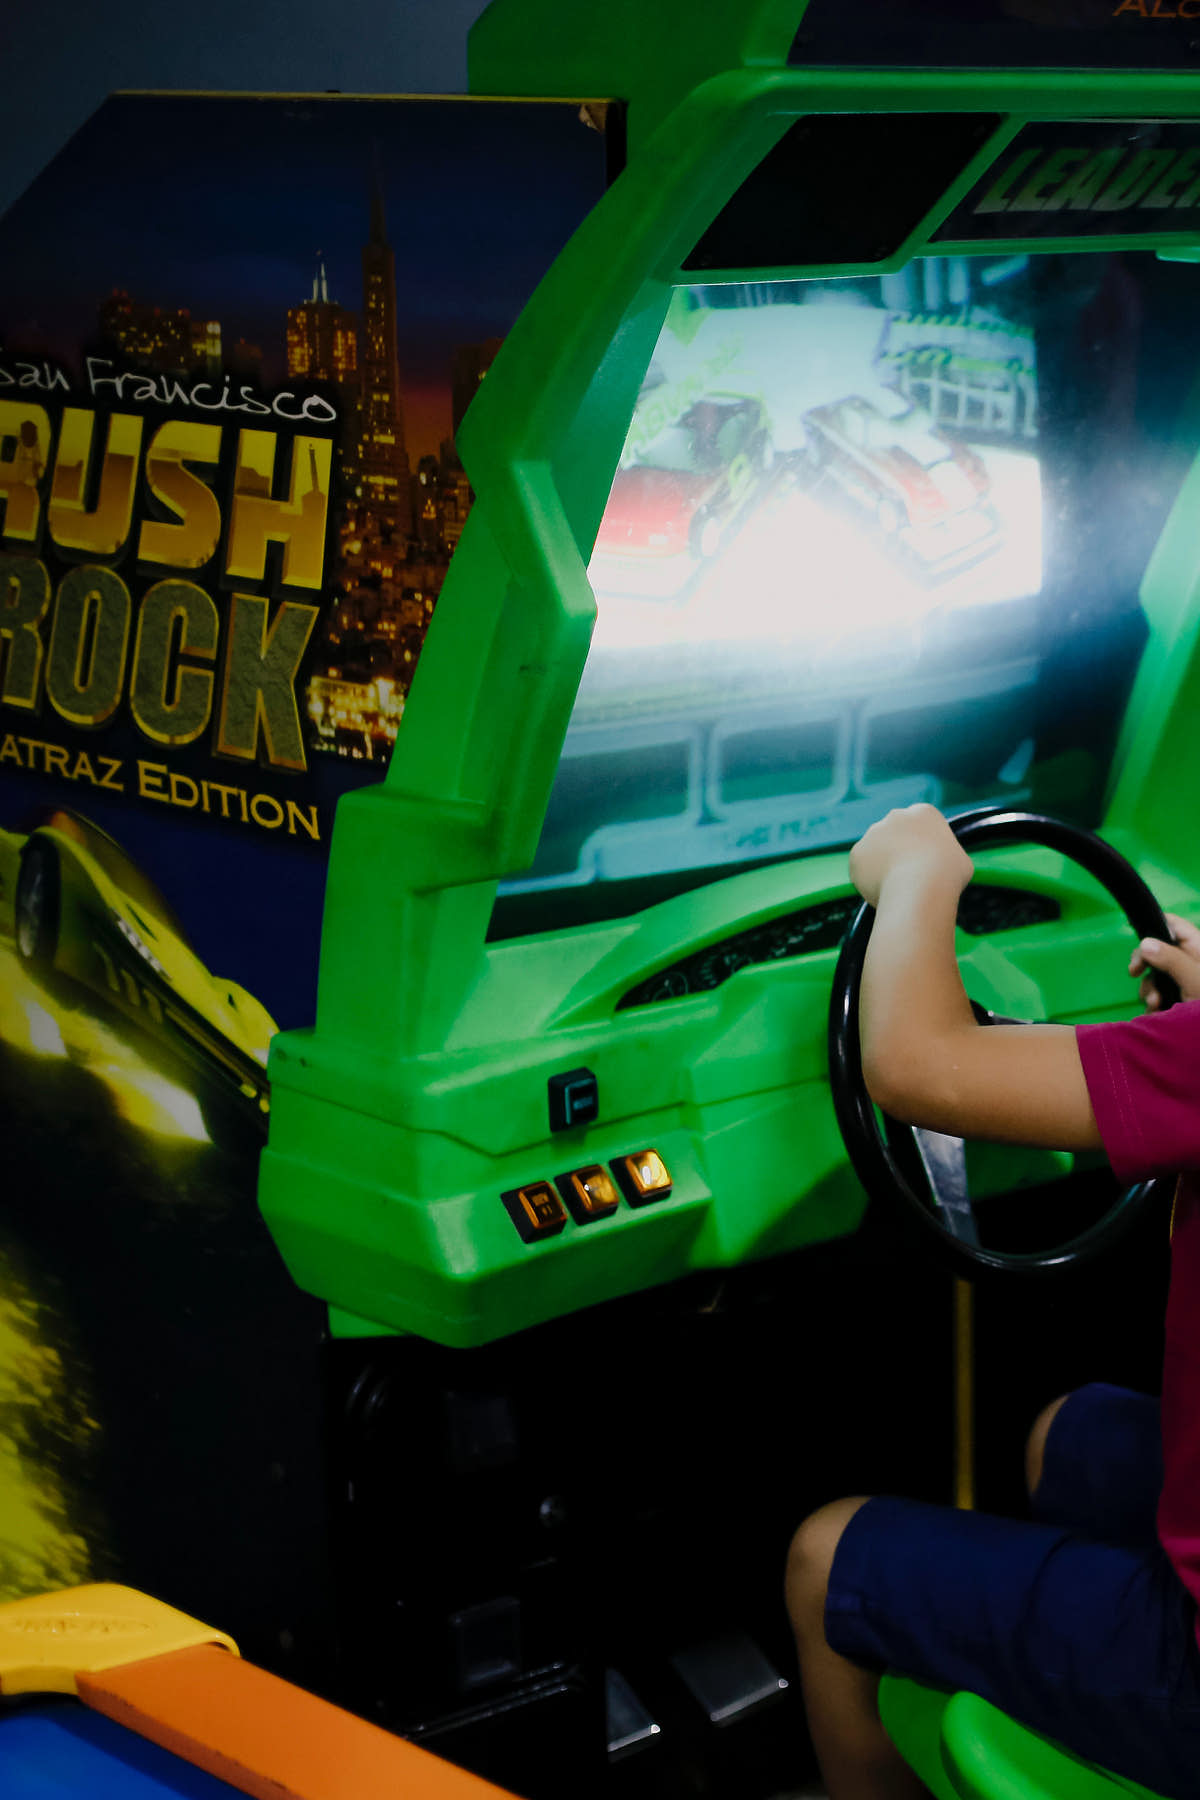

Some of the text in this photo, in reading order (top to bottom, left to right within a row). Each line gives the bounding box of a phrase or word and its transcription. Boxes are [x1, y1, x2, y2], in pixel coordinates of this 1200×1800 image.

[84, 356, 338, 423] Francisco
[0, 400, 334, 591] RUSH
[0, 553, 320, 773] ROCK
[136, 759, 321, 841] EDITION
